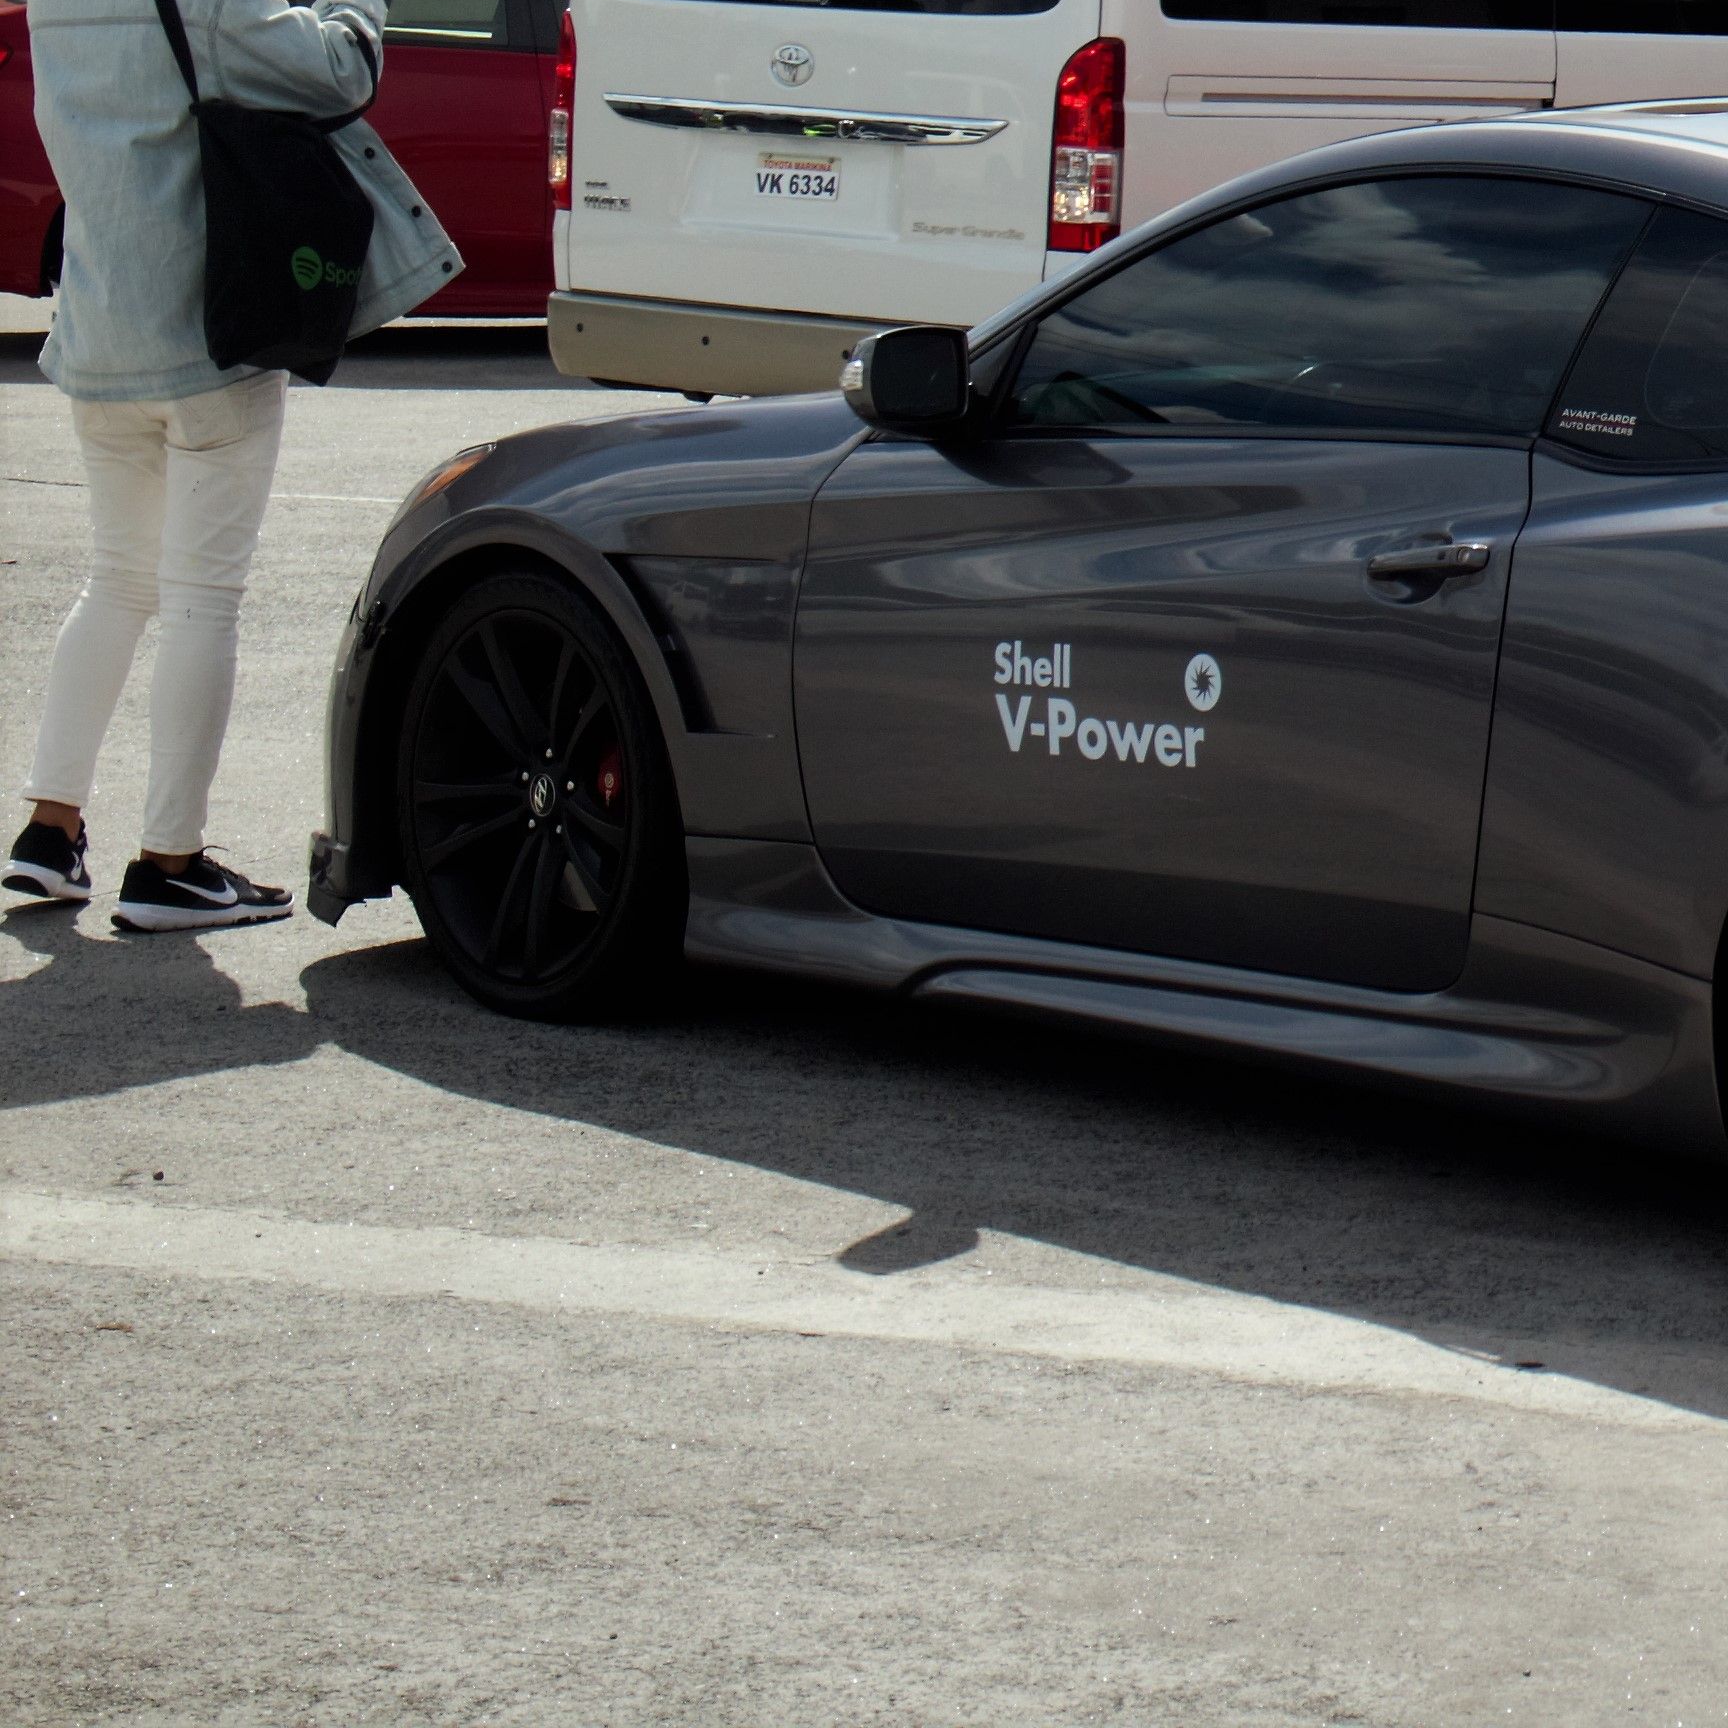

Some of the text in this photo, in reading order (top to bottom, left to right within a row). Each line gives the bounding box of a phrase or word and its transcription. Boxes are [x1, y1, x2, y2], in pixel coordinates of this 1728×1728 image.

[763, 159, 793, 171] TOYOTA
[756, 172, 836, 197] VK 6334
[325, 261, 362, 288] Spot
[1559, 420, 1634, 436] AUTO DETAILERS
[1561, 408, 1637, 425] AVANT-GARDE
[994, 640, 1071, 689] Shell
[995, 693, 1205, 769] V-Power
